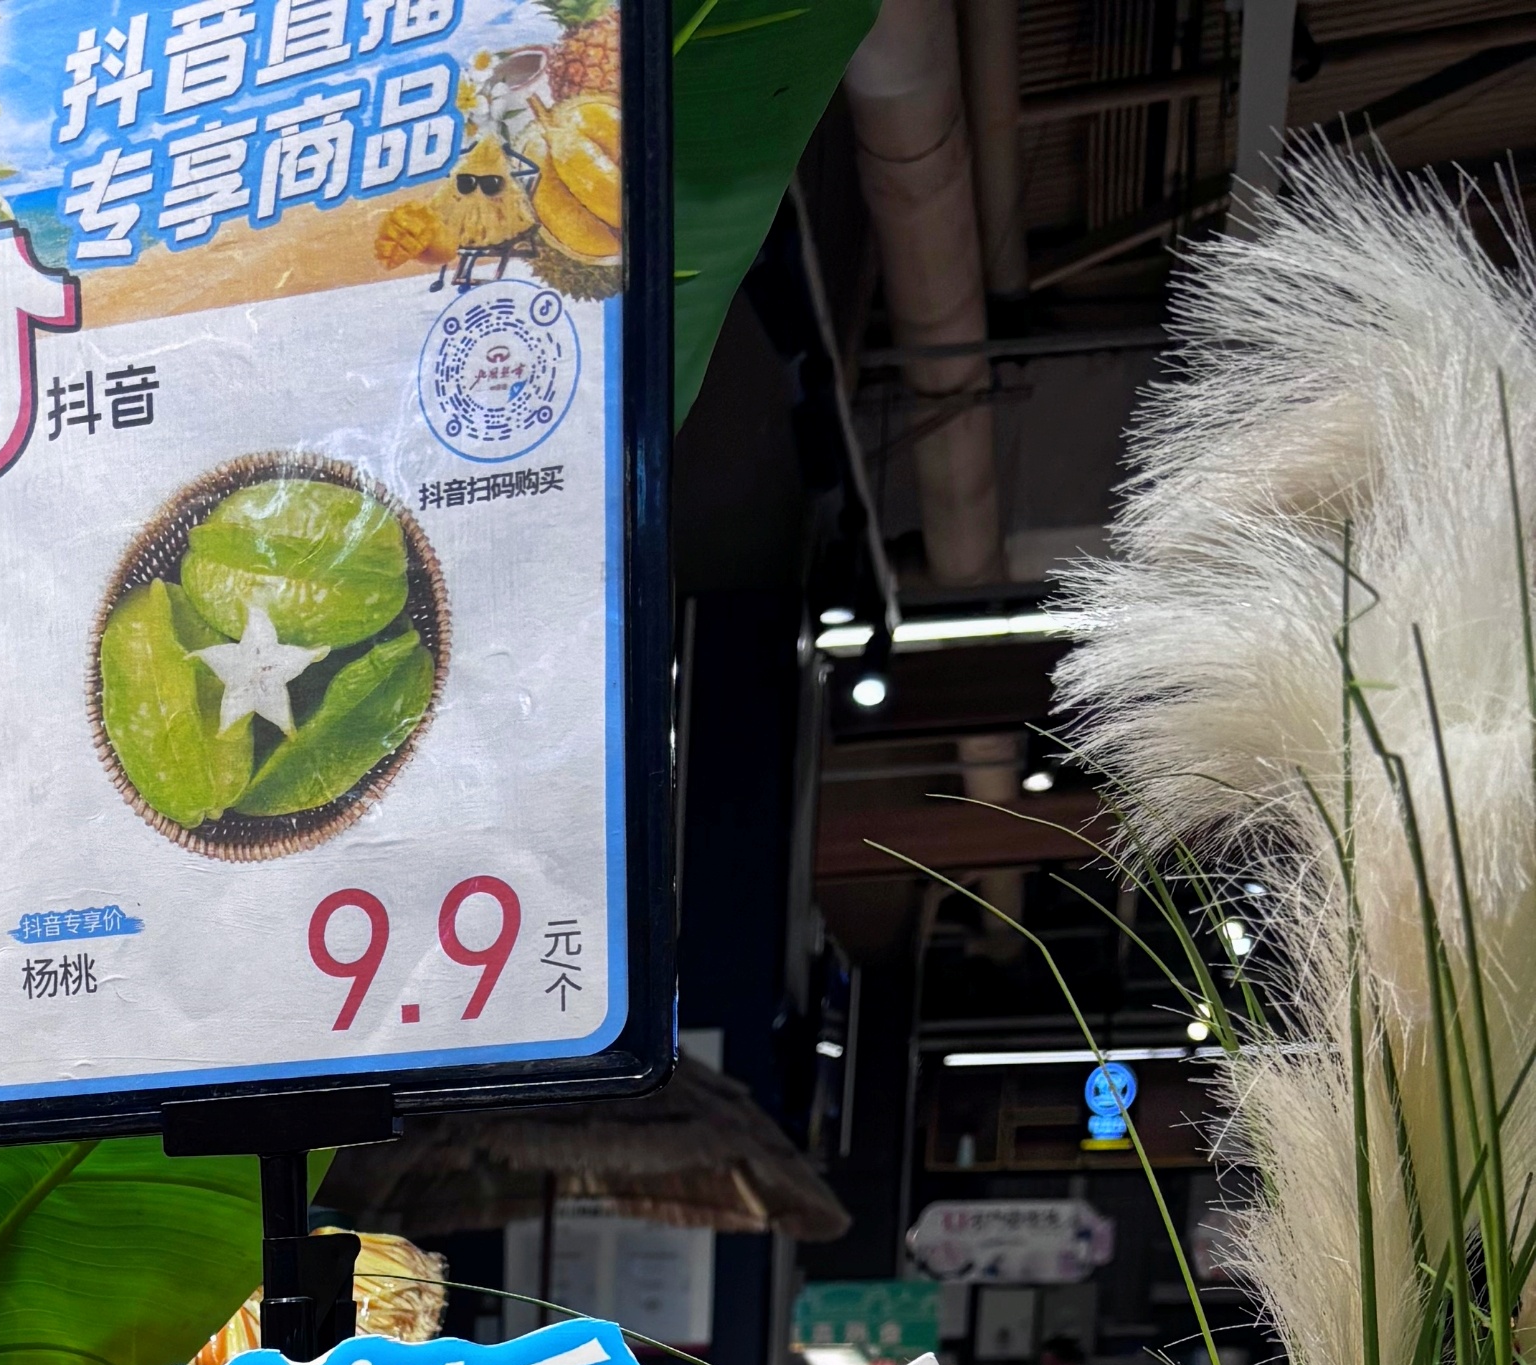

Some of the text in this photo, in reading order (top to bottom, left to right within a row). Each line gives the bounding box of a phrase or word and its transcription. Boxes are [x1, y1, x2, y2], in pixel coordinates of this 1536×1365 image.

[65, 64, 455, 260] 专享商品
[46, 363, 161, 442] 抖音
[419, 465, 564, 510] 抖音扫码购买
[20, 909, 124, 941] 抖音专享价
[307, 874, 522, 1032] 9.9
[21, 954, 98, 1001] 杨桃
